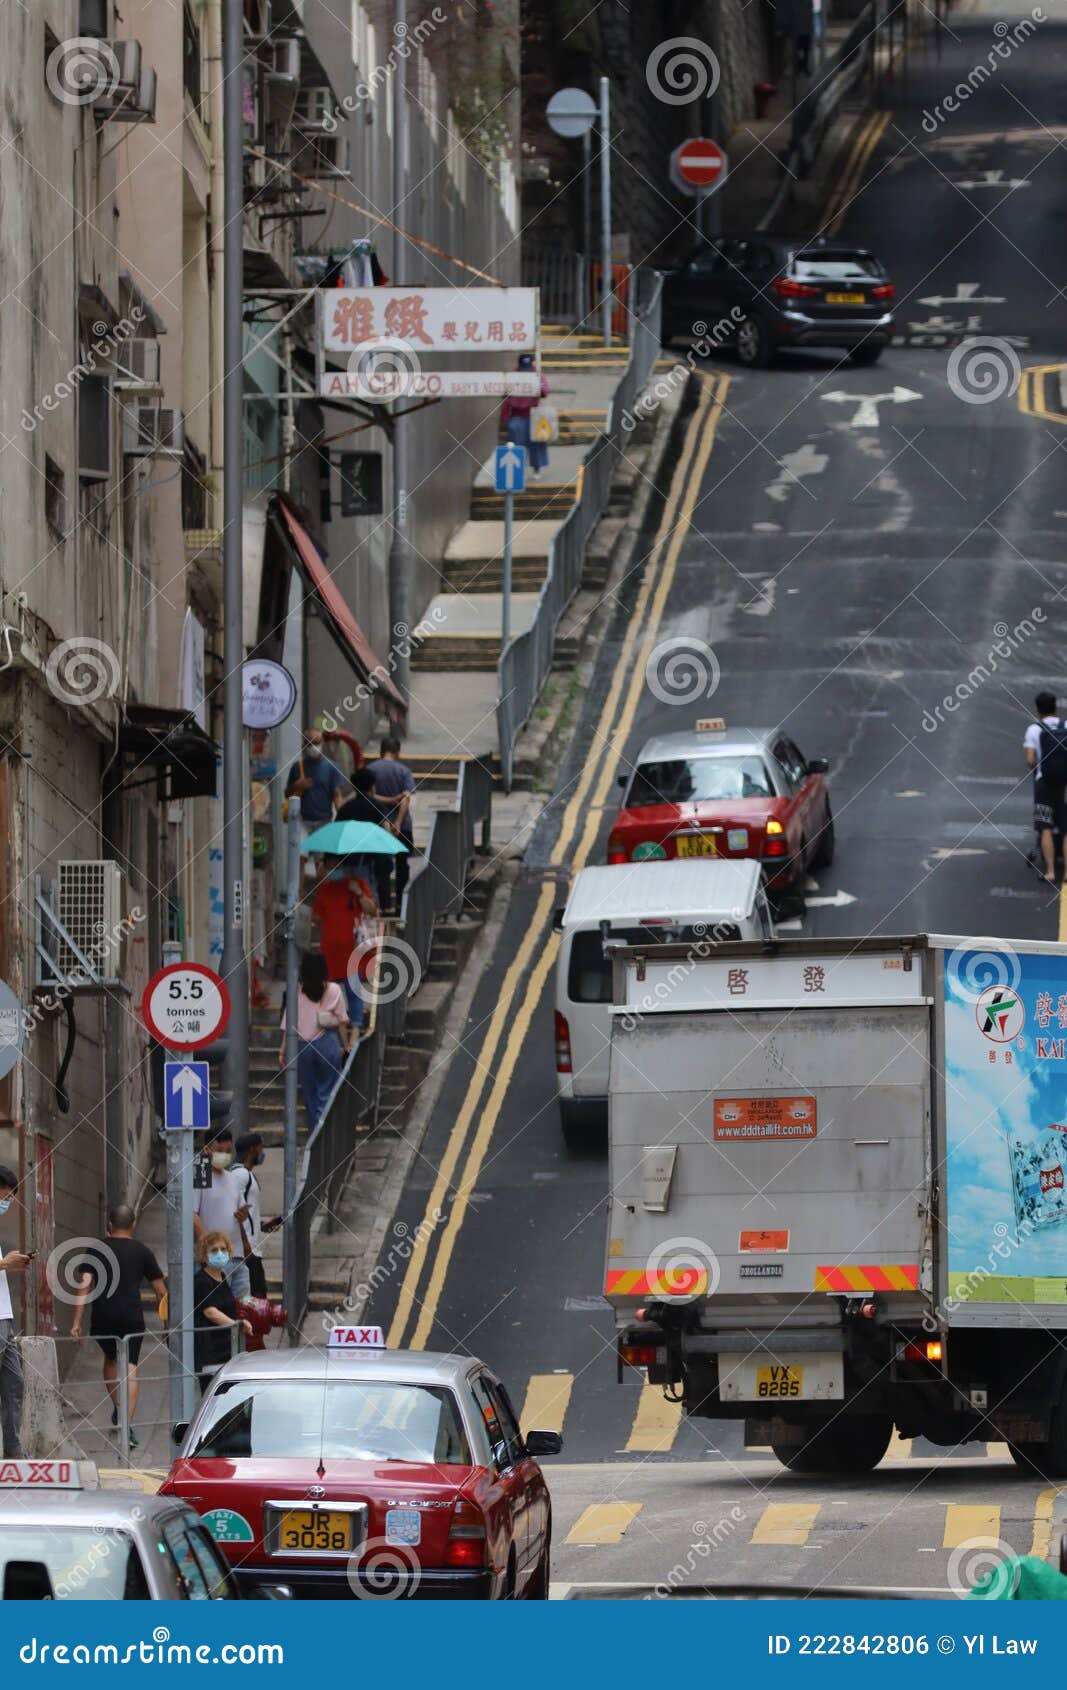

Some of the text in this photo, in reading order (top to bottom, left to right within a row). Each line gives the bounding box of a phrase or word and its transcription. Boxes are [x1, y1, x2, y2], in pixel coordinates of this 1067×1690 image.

[441, 320, 528, 343] 嬰兒用品
[329, 375, 358, 394] AH
[368, 374, 400, 394] CHI
[698, 721, 722, 731] TAXI
[169, 980, 203, 999] 5.5
[166, 1007, 206, 1017] tonnes
[172, 1020, 201, 1033] 公噸
[1036, 1038, 1065, 1059] KAI
[717, 1123, 813, 1137] www.dddtaillift.com.hk
[334, 1329, 378, 1344] TAXI
[770, 1366, 790, 1380] VX
[758, 1381, 800, 1397] 8285
[210, 1512, 233, 1520] TAXI
[301, 1512, 330, 1531] JR
[216, 1520, 228, 1532] 5
[209, 1532, 241, 1540] EATS
[285, 1531, 346, 1550] 3038
